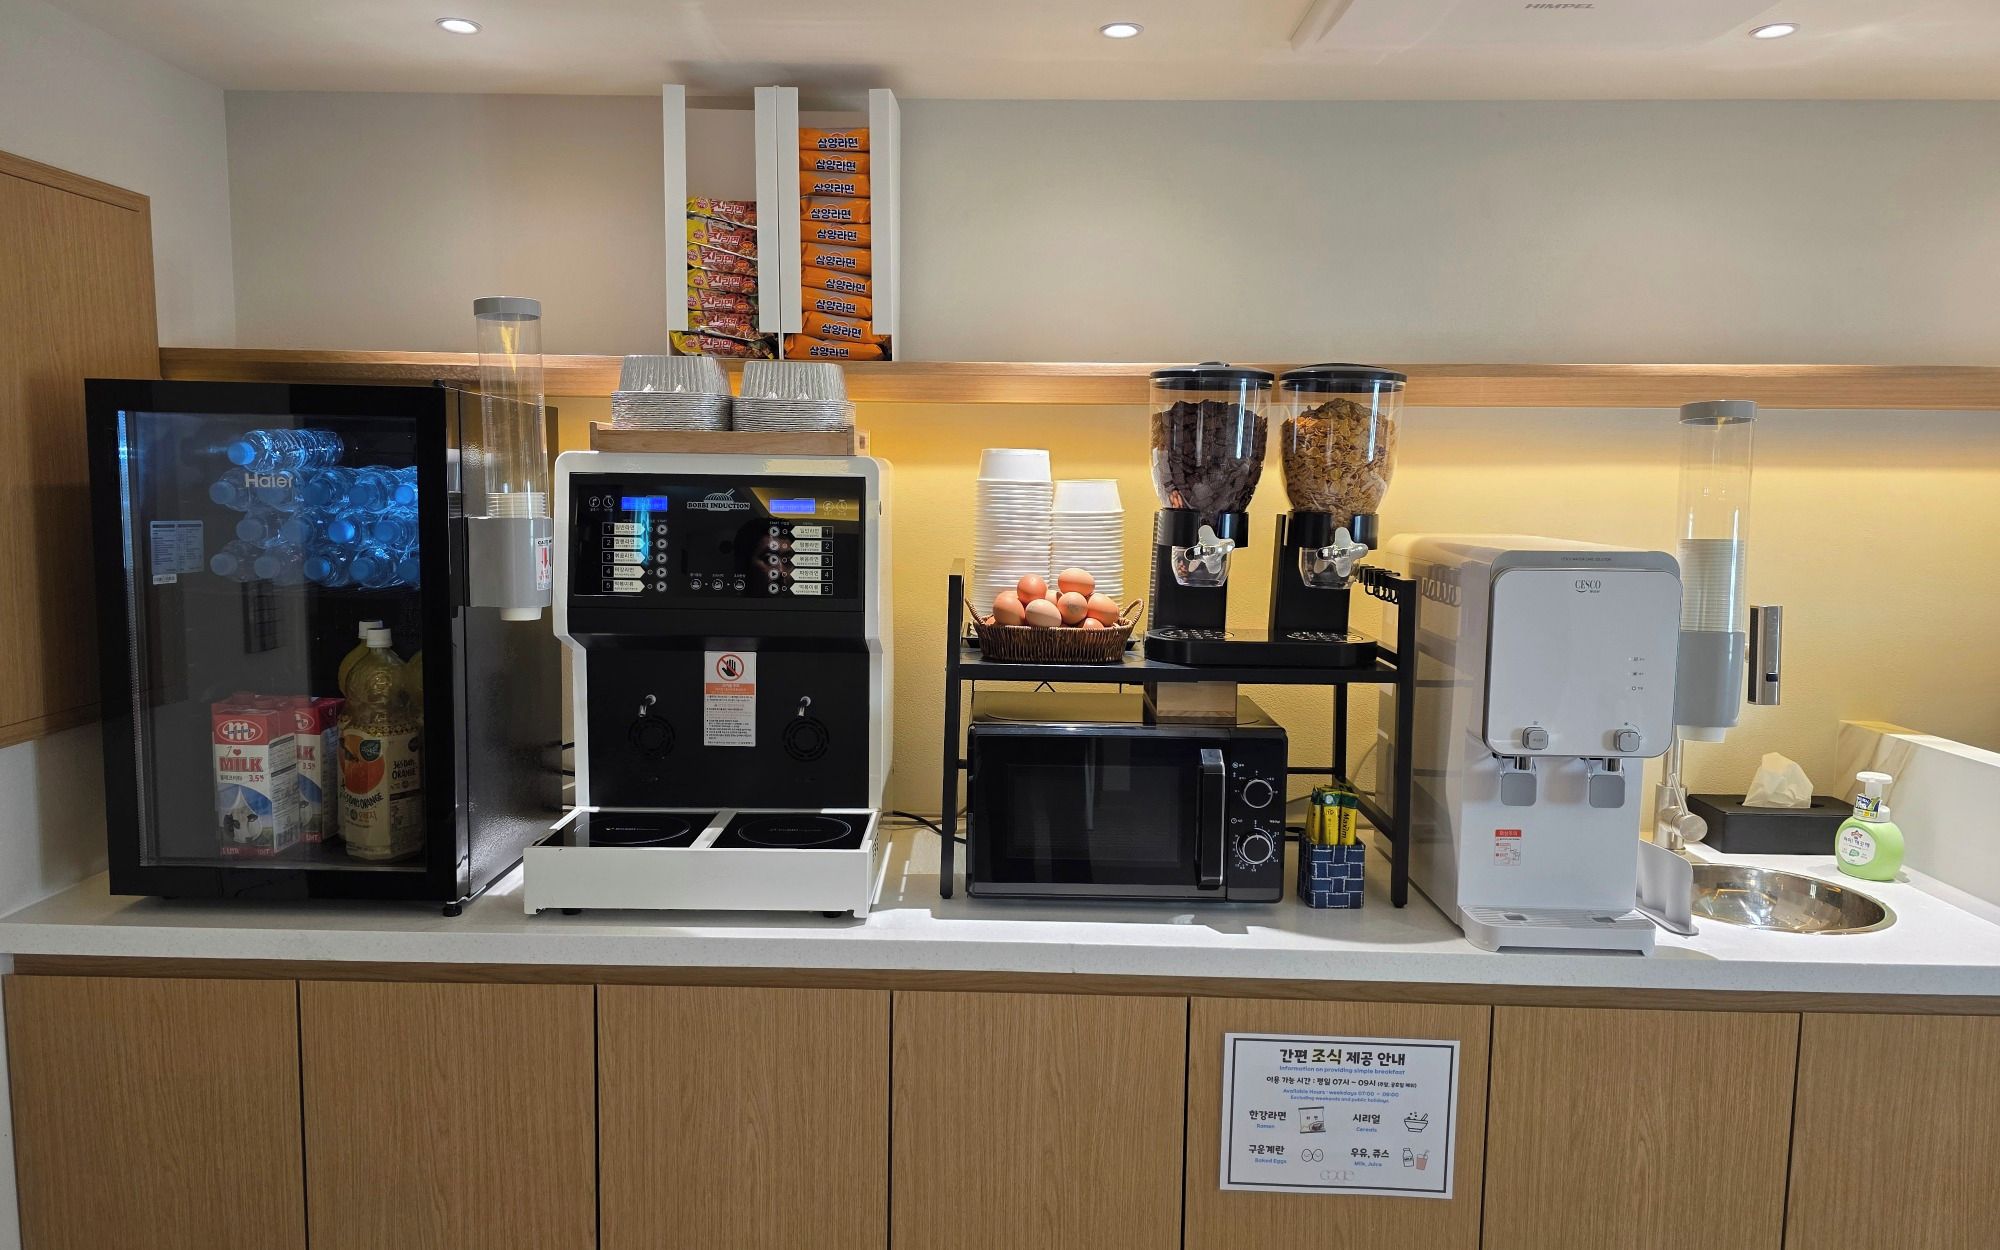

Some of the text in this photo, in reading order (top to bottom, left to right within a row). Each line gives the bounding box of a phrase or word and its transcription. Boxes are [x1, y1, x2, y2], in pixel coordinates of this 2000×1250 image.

[817, 137, 858, 148] 삼양라면
[816, 159, 856, 172] 삼양라면
[814, 183, 854, 194] 삼양라면
[711, 200, 744, 214] 진라면
[810, 208, 851, 219] 삼양라면
[708, 232, 740, 246] 진라면
[817, 229, 857, 241] 삼양라면
[702, 250, 734, 264] 진라면
[815, 255, 856, 268] 삼양라면
[708, 275, 740, 287] 진라면
[826, 278, 866, 293] 삼양라면
[701, 297, 734, 310] 진라면
[816, 300, 856, 313] 삼양라면
[822, 323, 862, 338] 삼양라면
[701, 338, 733, 350] 진라면
[810, 346, 849, 357] 삼양라면
[245, 473, 294, 488] Haier
[1575, 579, 1601, 589] CESCO
[219, 757, 263, 772] MILK
[360, 793, 384, 809] ORANGE
[1342, 811, 1350, 838] Maxim
[1280, 1049, 1405, 1066] 간편 조식 제공 안내
[1266, 1076, 1279, 1084] 이용
[1297, 1077, 1310, 1085] 시간
[1317, 1078, 1331, 1086] 평일
[1249, 1110, 1287, 1120] 한강라면
[1353, 1114, 1380, 1124] 시리얼
[1249, 1144, 1285, 1155] 구운계란
[1351, 1147, 1389, 1158] 우유, 쥬스
